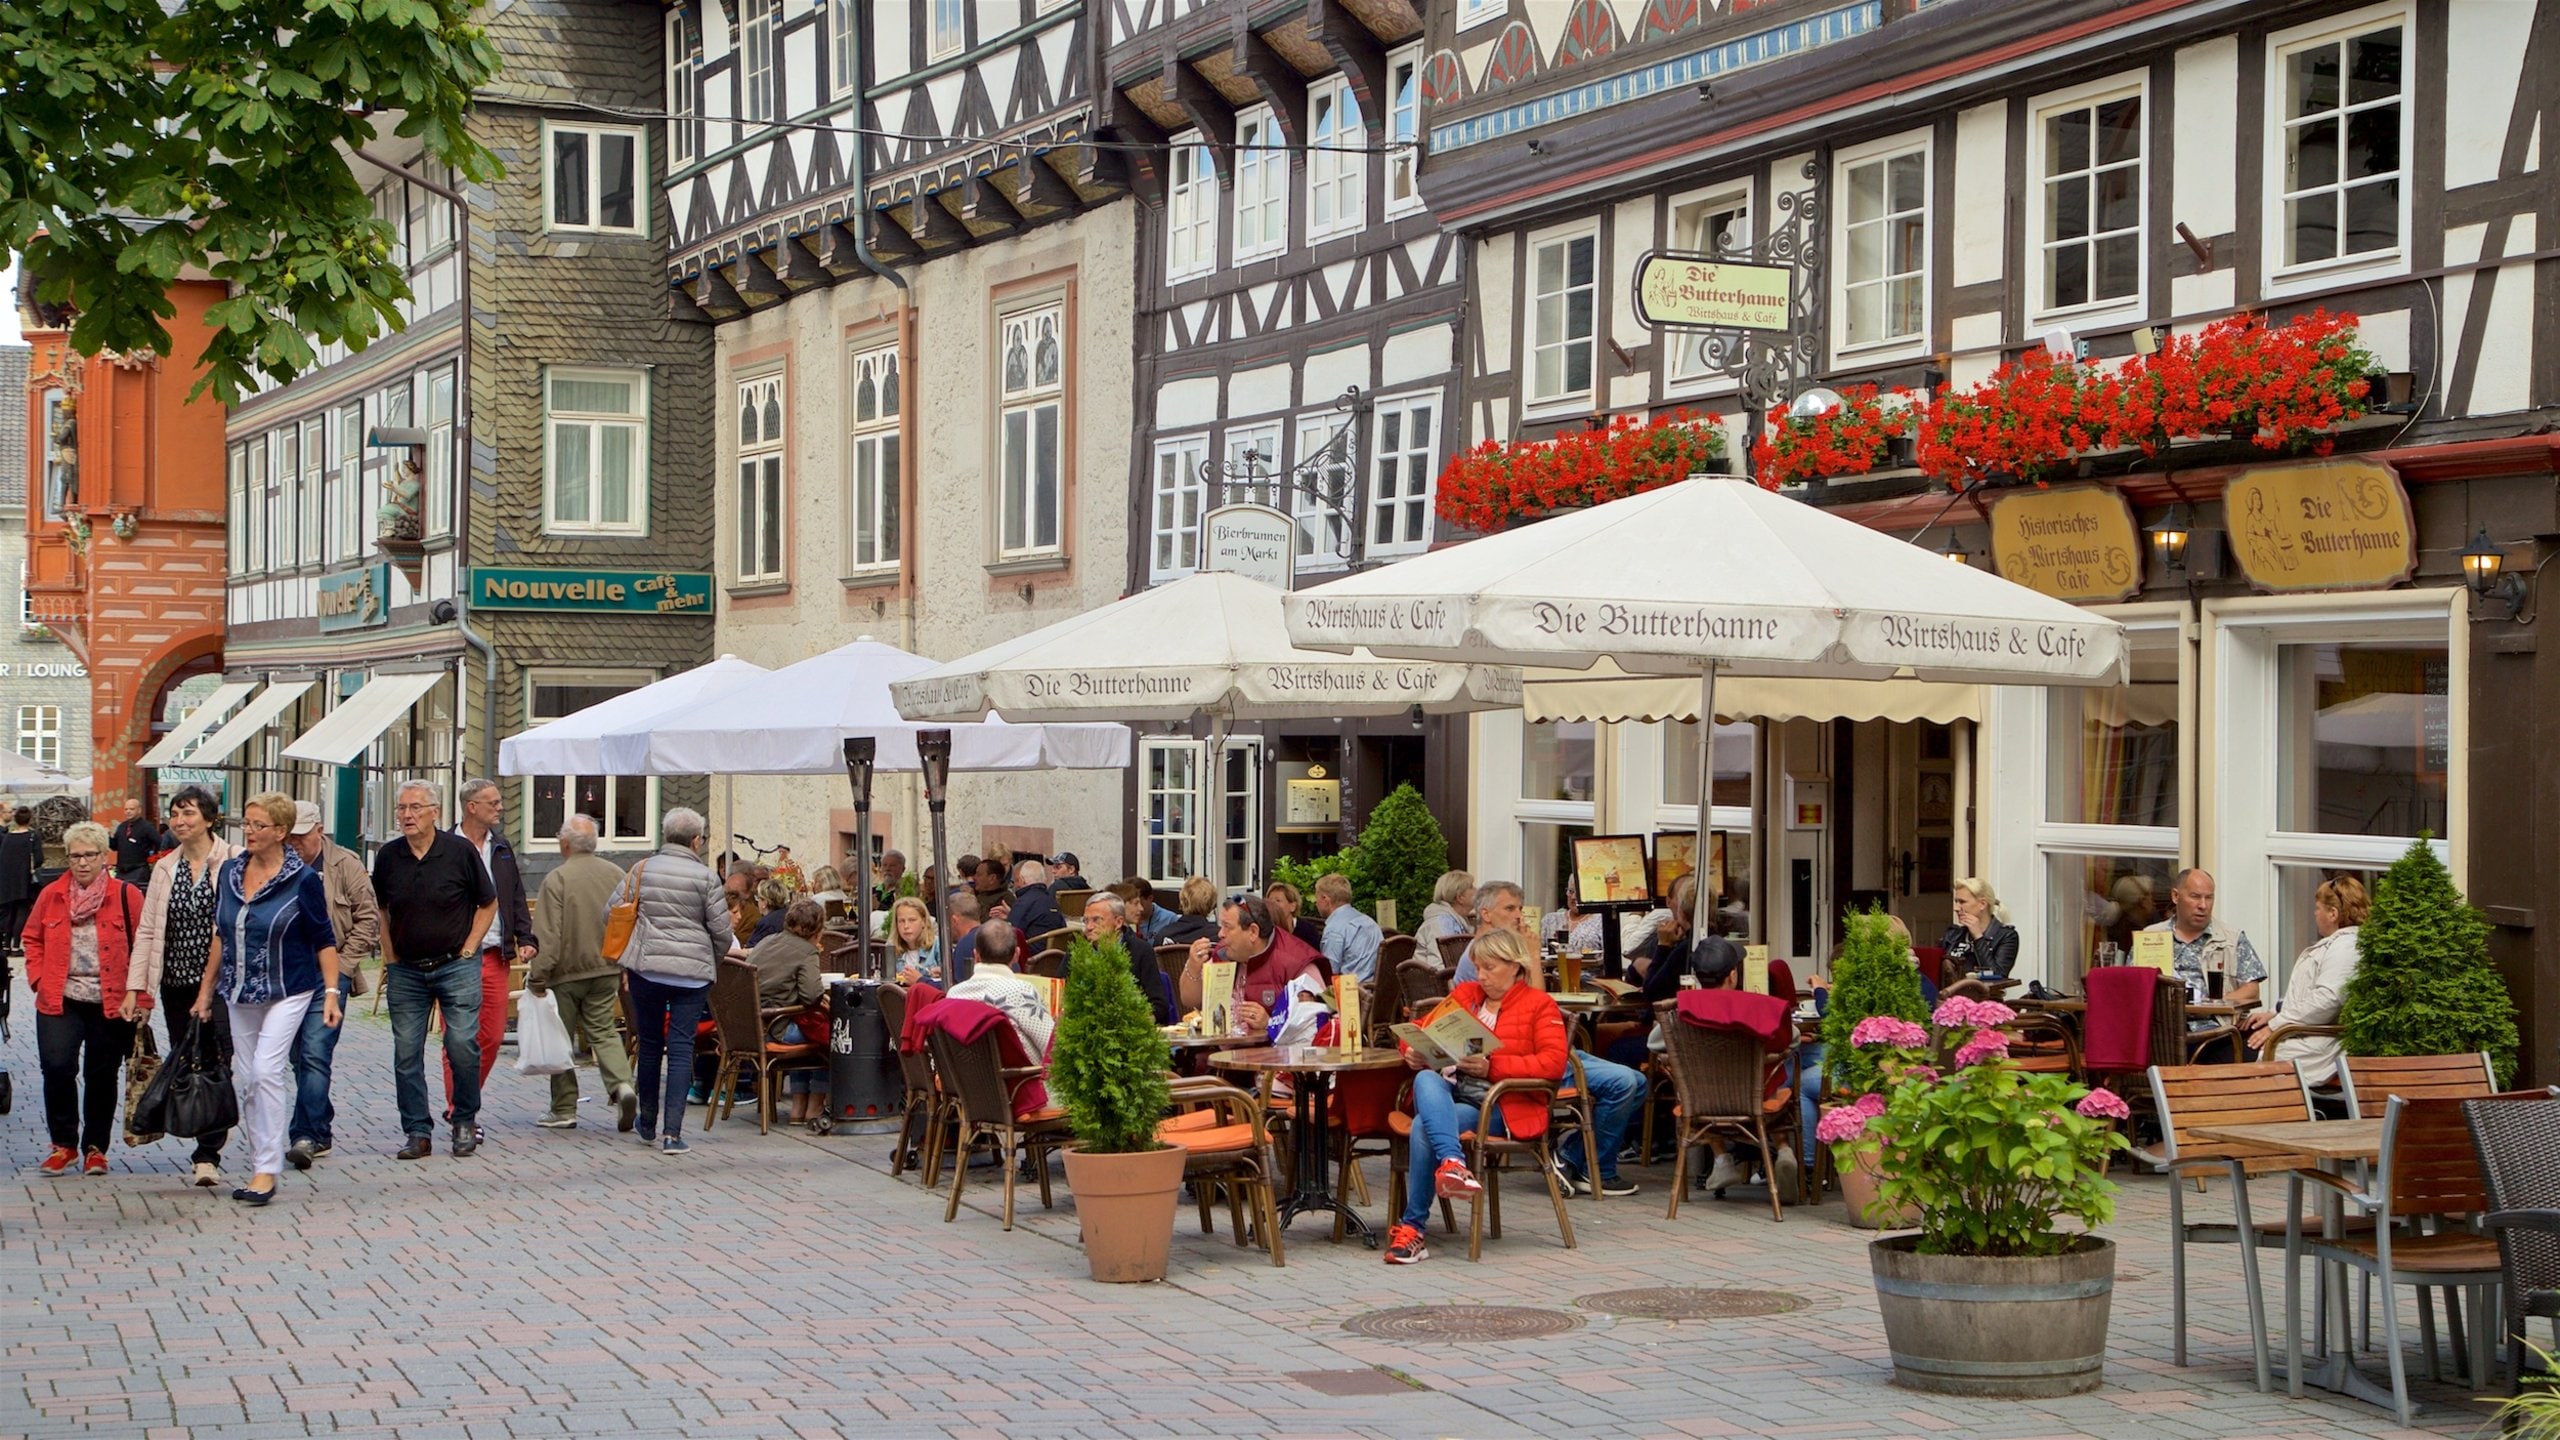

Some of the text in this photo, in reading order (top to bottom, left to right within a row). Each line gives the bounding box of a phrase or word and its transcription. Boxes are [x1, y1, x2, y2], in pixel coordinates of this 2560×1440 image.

[1685, 266, 1716, 283] Die
[1679, 284, 1786, 308] Butterhanne
[1687, 306, 1739, 322] Wirtshaus
[1742, 312, 1751, 321] &
[2300, 496, 2332, 520] Die
[1212, 525, 1286, 542] Bierbrunnen
[2018, 511, 2098, 542] Historisches
[1221, 545, 1278, 562] am Markt
[2301, 528, 2400, 559] Butterhanne
[2028, 544, 2100, 571] Wirtshaus
[485, 573, 676, 601] Nouvelle café
[665, 587, 679, 599] &
[656, 593, 705, 613] mehr
[1306, 599, 1446, 636] Wirtshaus & Cafe
[1533, 602, 1778, 645] Die Butterhanne
[1880, 615, 2086, 664] Wirtshaus & Cafe
[1024, 672, 1192, 699] Die Butterhanne
[1267, 666, 1438, 695] Wirtshaus & Cafe
